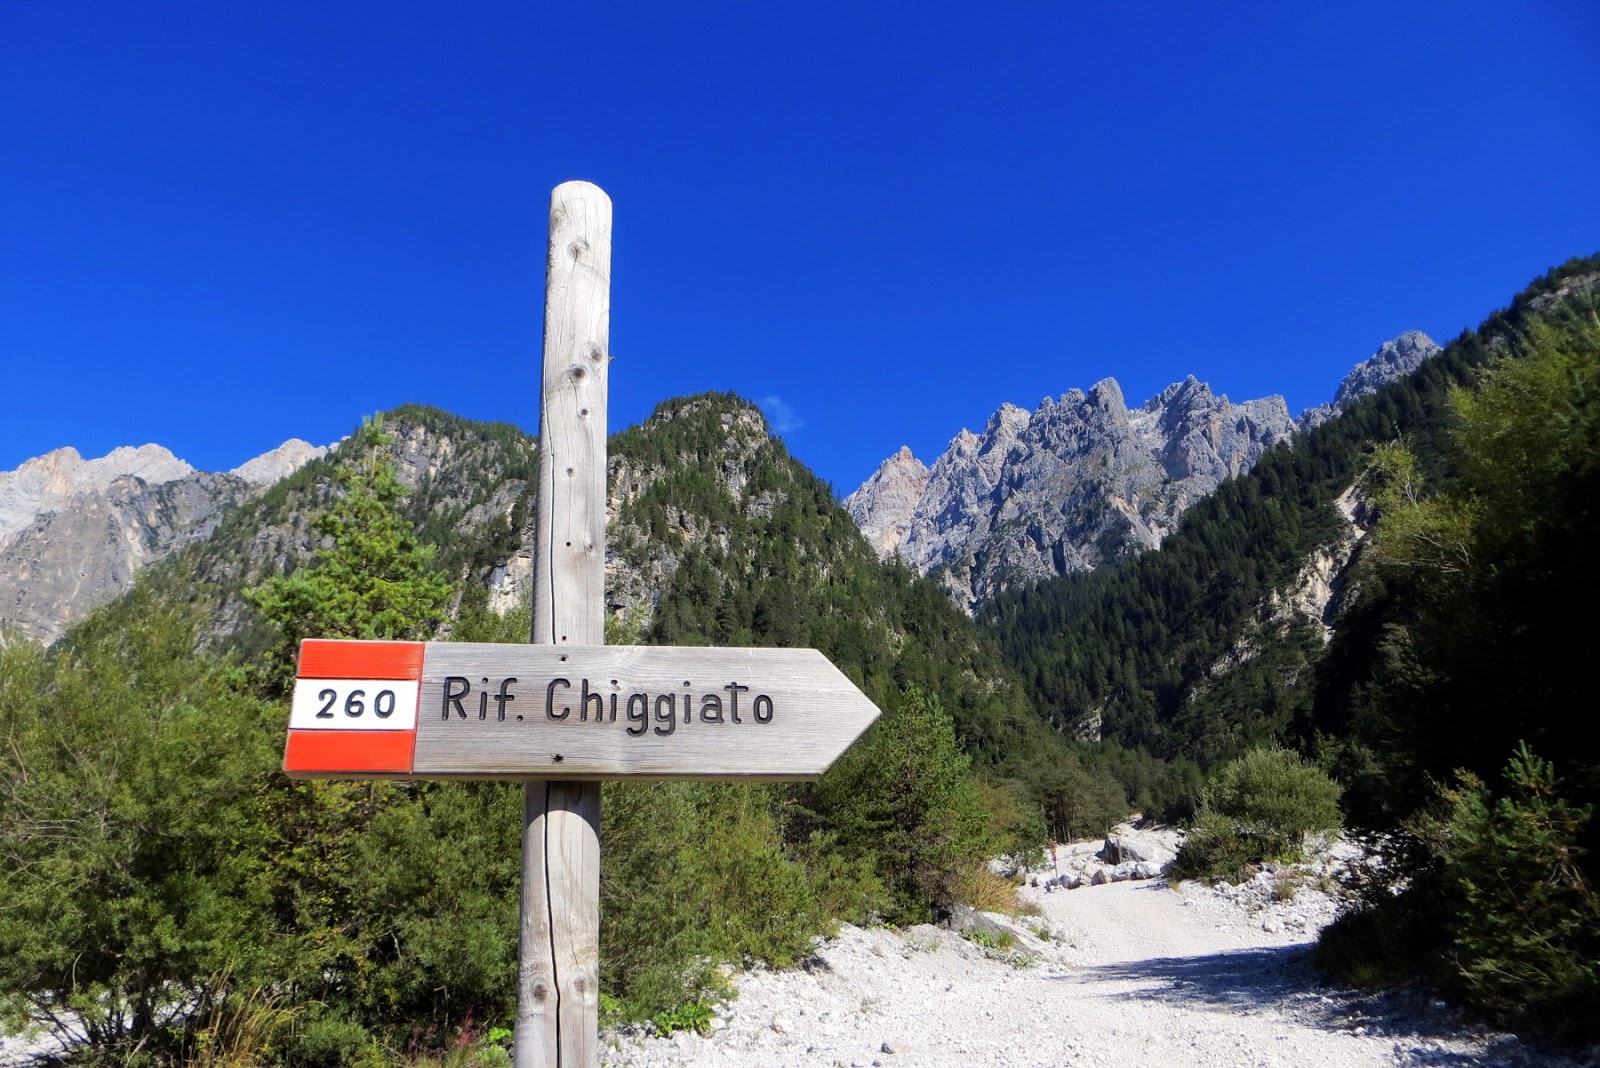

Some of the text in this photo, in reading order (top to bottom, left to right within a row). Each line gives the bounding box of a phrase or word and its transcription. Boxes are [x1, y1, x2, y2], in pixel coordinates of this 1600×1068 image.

[315, 688, 395, 719] 260
[440, 675, 776, 738] Rif. Chiggiato
